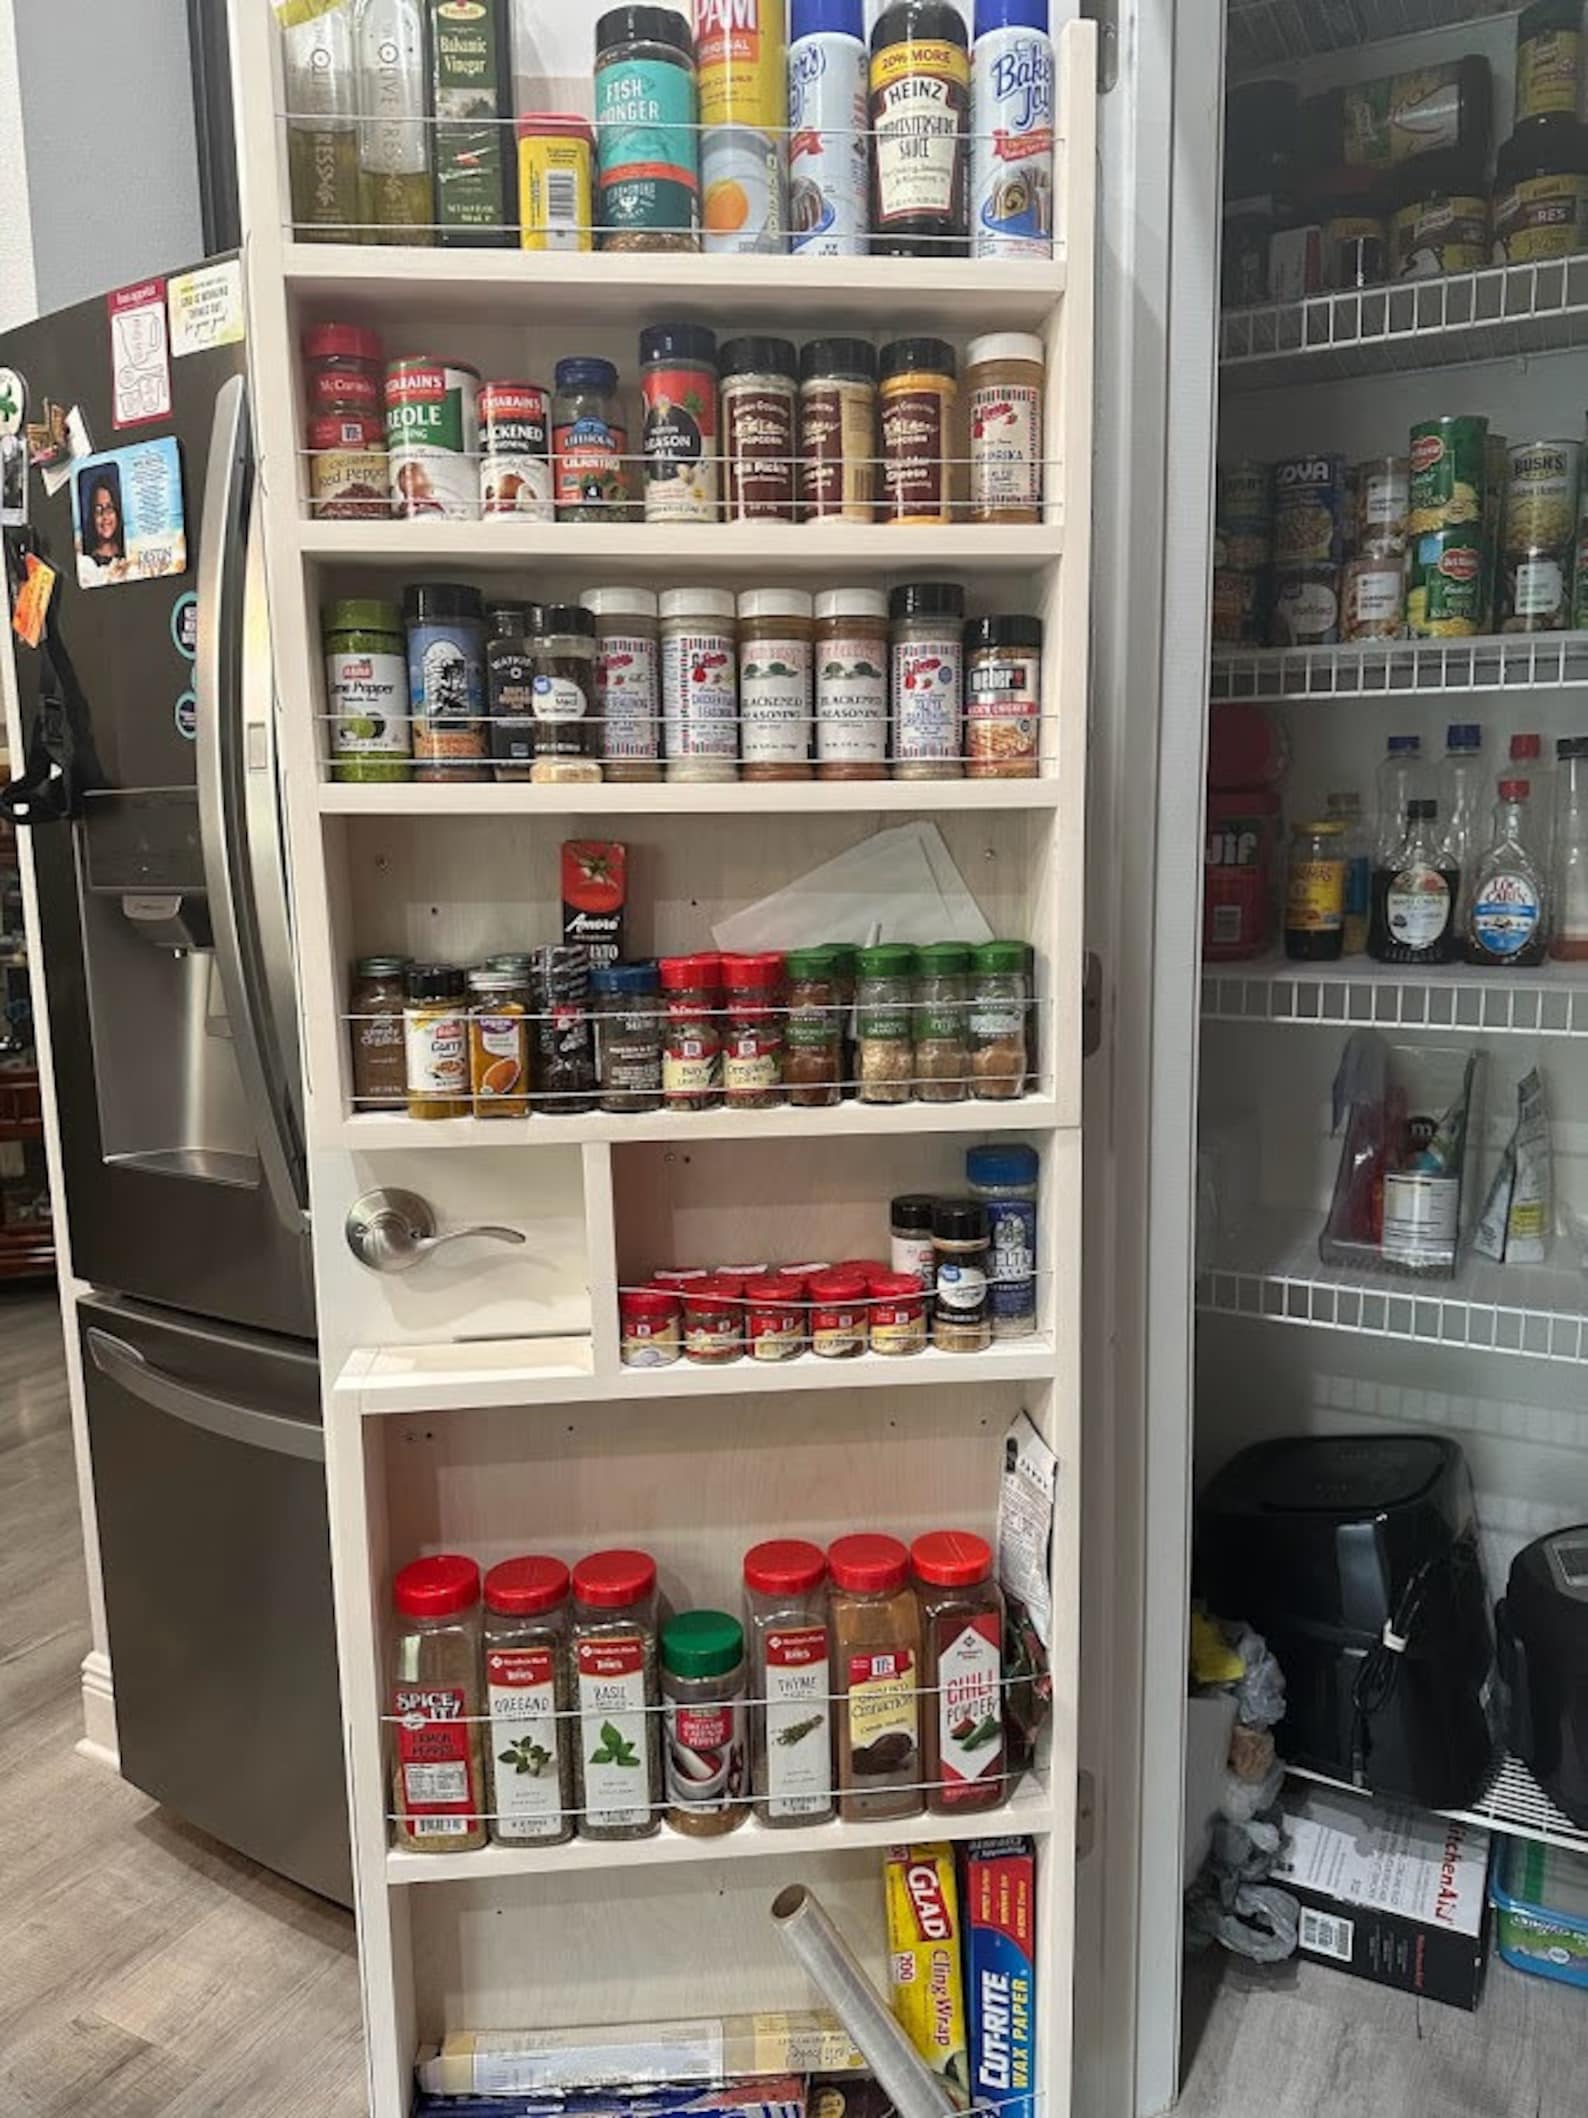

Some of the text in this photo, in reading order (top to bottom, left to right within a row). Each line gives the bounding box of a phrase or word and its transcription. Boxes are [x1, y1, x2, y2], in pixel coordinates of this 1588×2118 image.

[692, 0, 757, 42] PAM
[440, 35, 487, 54] Balsamic
[444, 55, 486, 77] Vinegar
[881, 48, 951, 70] 20% MORE
[606, 77, 643, 103] FISH
[888, 79, 944, 104] HEINZ
[899, 138, 930, 161] SAUCE
[1513, 453, 1565, 474] BUSH'S
[1204, 831, 1257, 866] Jif
[945, 1668, 993, 1706] CHILI
[396, 1692, 455, 1713] SPICE
[907, 1865, 948, 1940] GLAD
[899, 1954, 914, 1981] 200
[932, 1949, 954, 2046] Cling Wrap
[979, 1968, 1011, 2089] CUT-RITE
[1011, 1979, 1029, 2089] WAX PAPER
